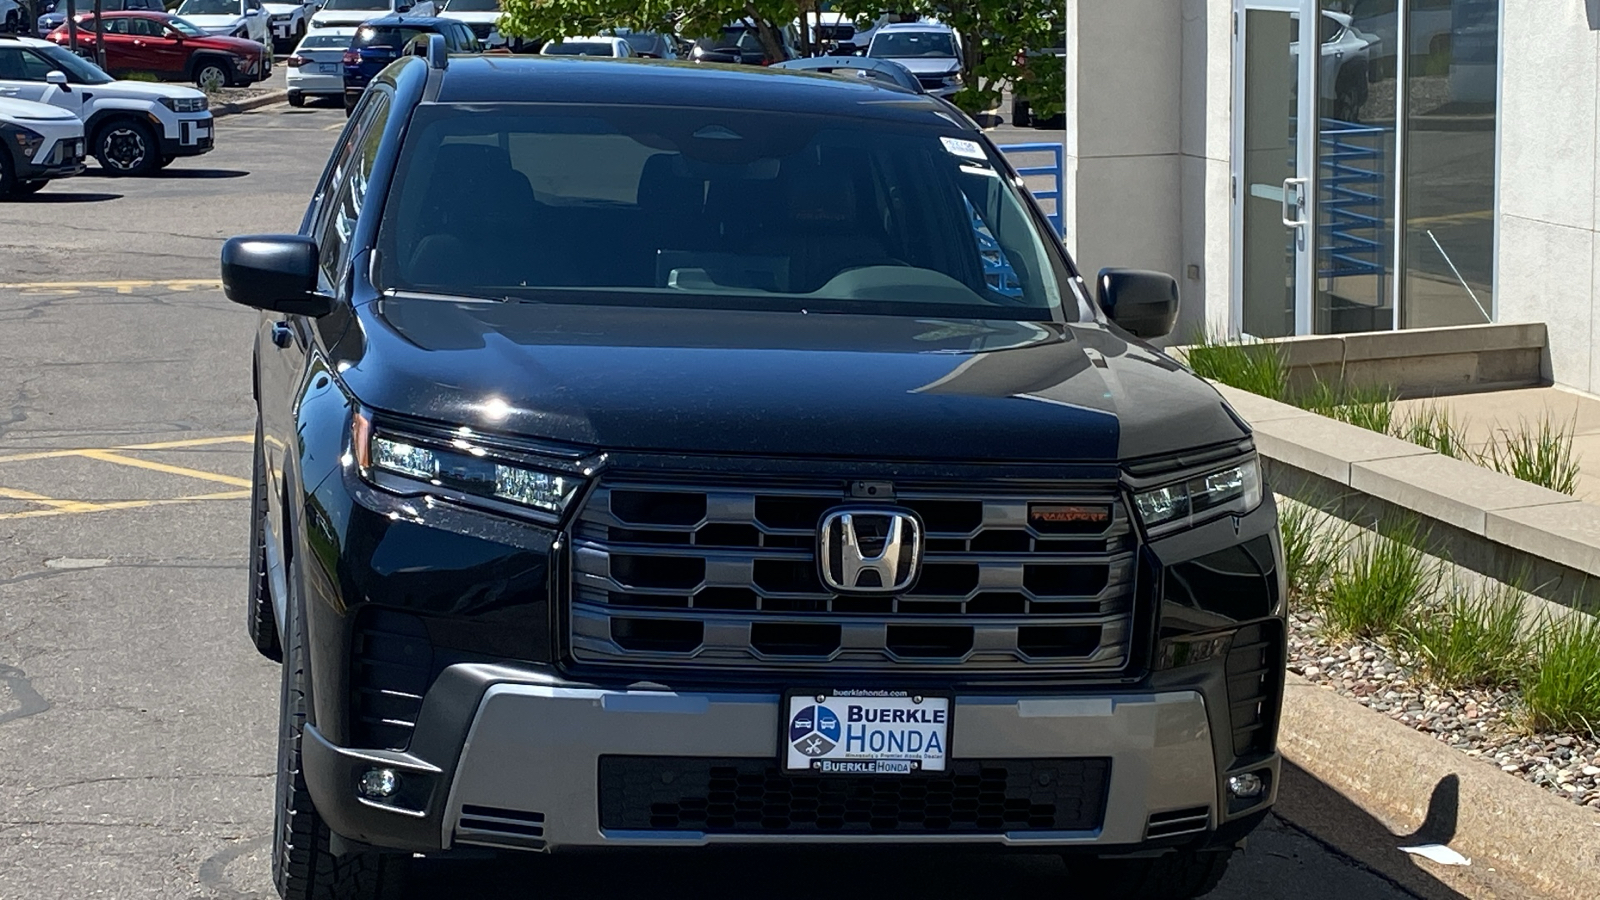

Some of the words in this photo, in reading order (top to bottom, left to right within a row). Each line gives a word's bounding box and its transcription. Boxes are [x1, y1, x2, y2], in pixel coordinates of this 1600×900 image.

[832, 688, 908, 697] buerklehonda.com
[847, 705, 945, 723] BUERKLE
[845, 724, 943, 753] HONDA
[822, 761, 875, 771] BUERKLE
[877, 761, 909, 772] HONDA
